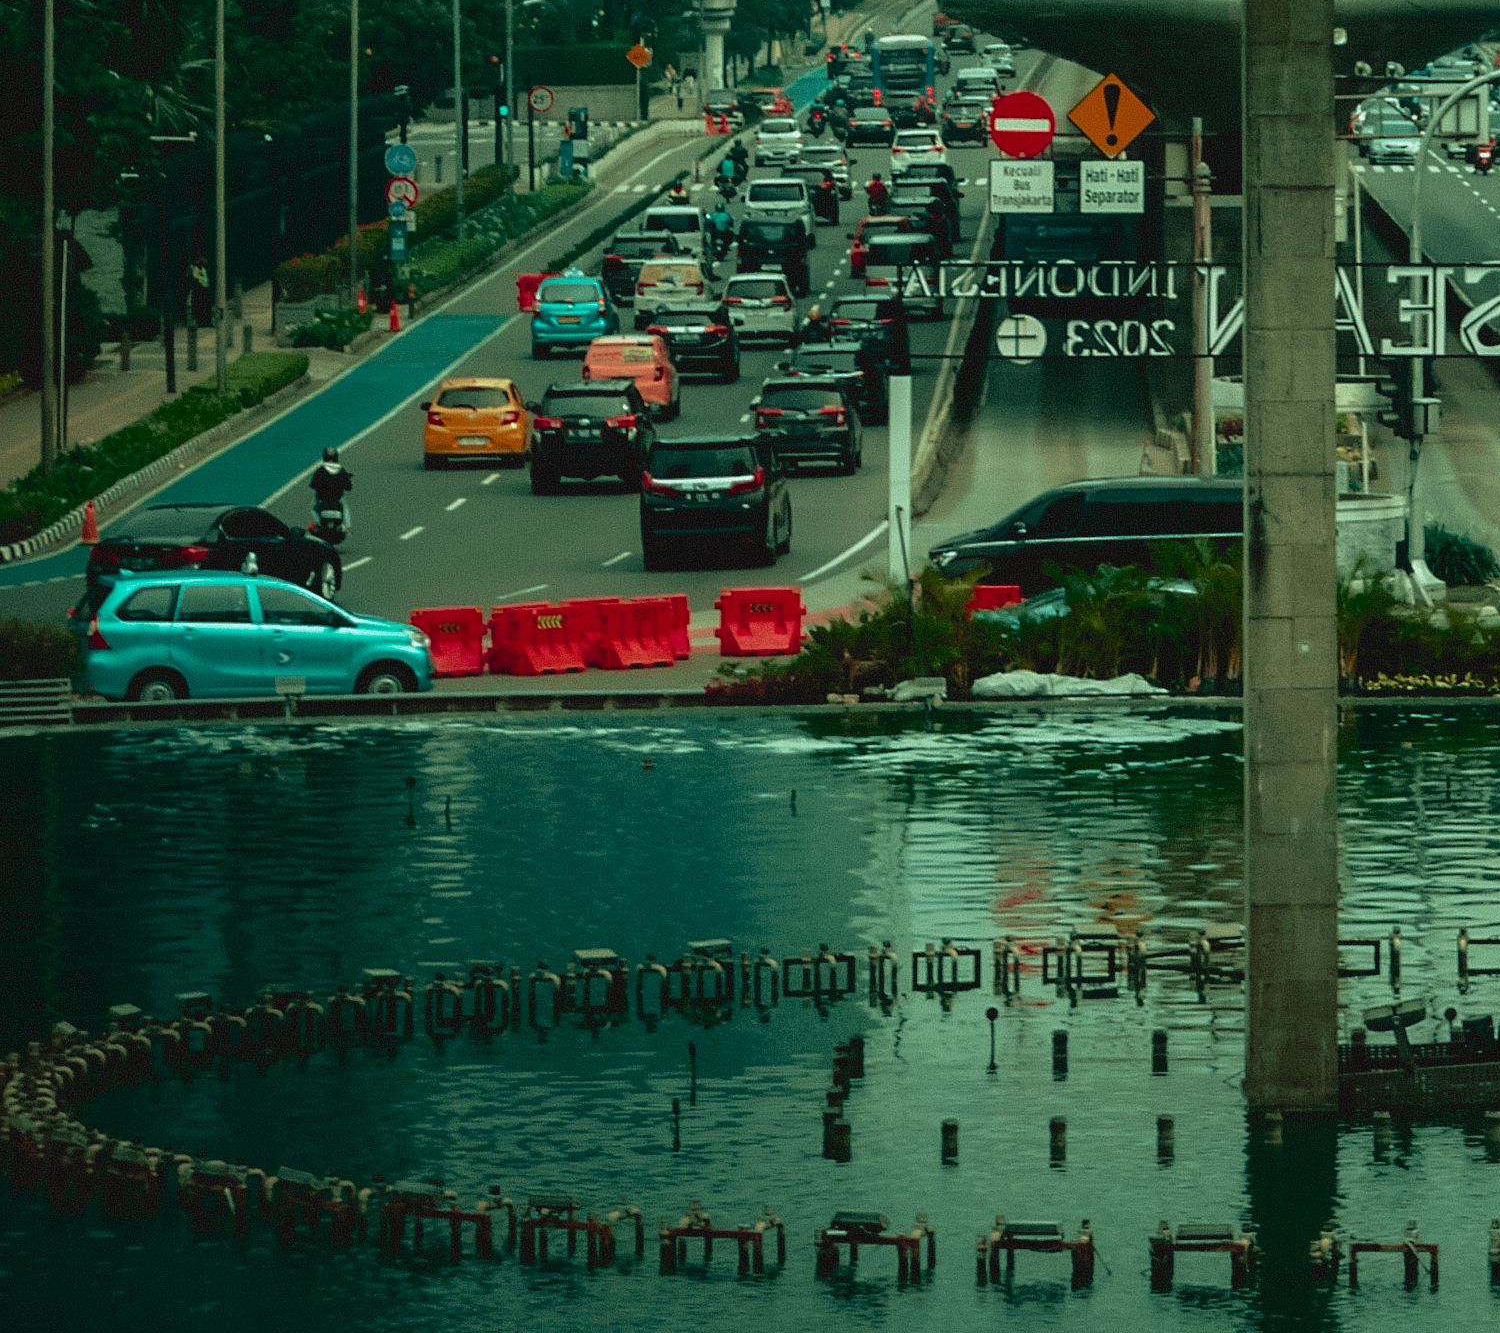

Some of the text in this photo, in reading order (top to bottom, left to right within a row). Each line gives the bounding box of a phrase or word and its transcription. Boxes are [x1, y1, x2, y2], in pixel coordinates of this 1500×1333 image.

[1003, 166, 1040, 177] Kecuali
[1086, 168, 1108, 182] Hati
[1116, 168, 1139, 182] Hati
[1013, 179, 1031, 191] Bus
[992, 194, 1051, 209] Transjakarta
[1085, 190, 1140, 207] Separator
